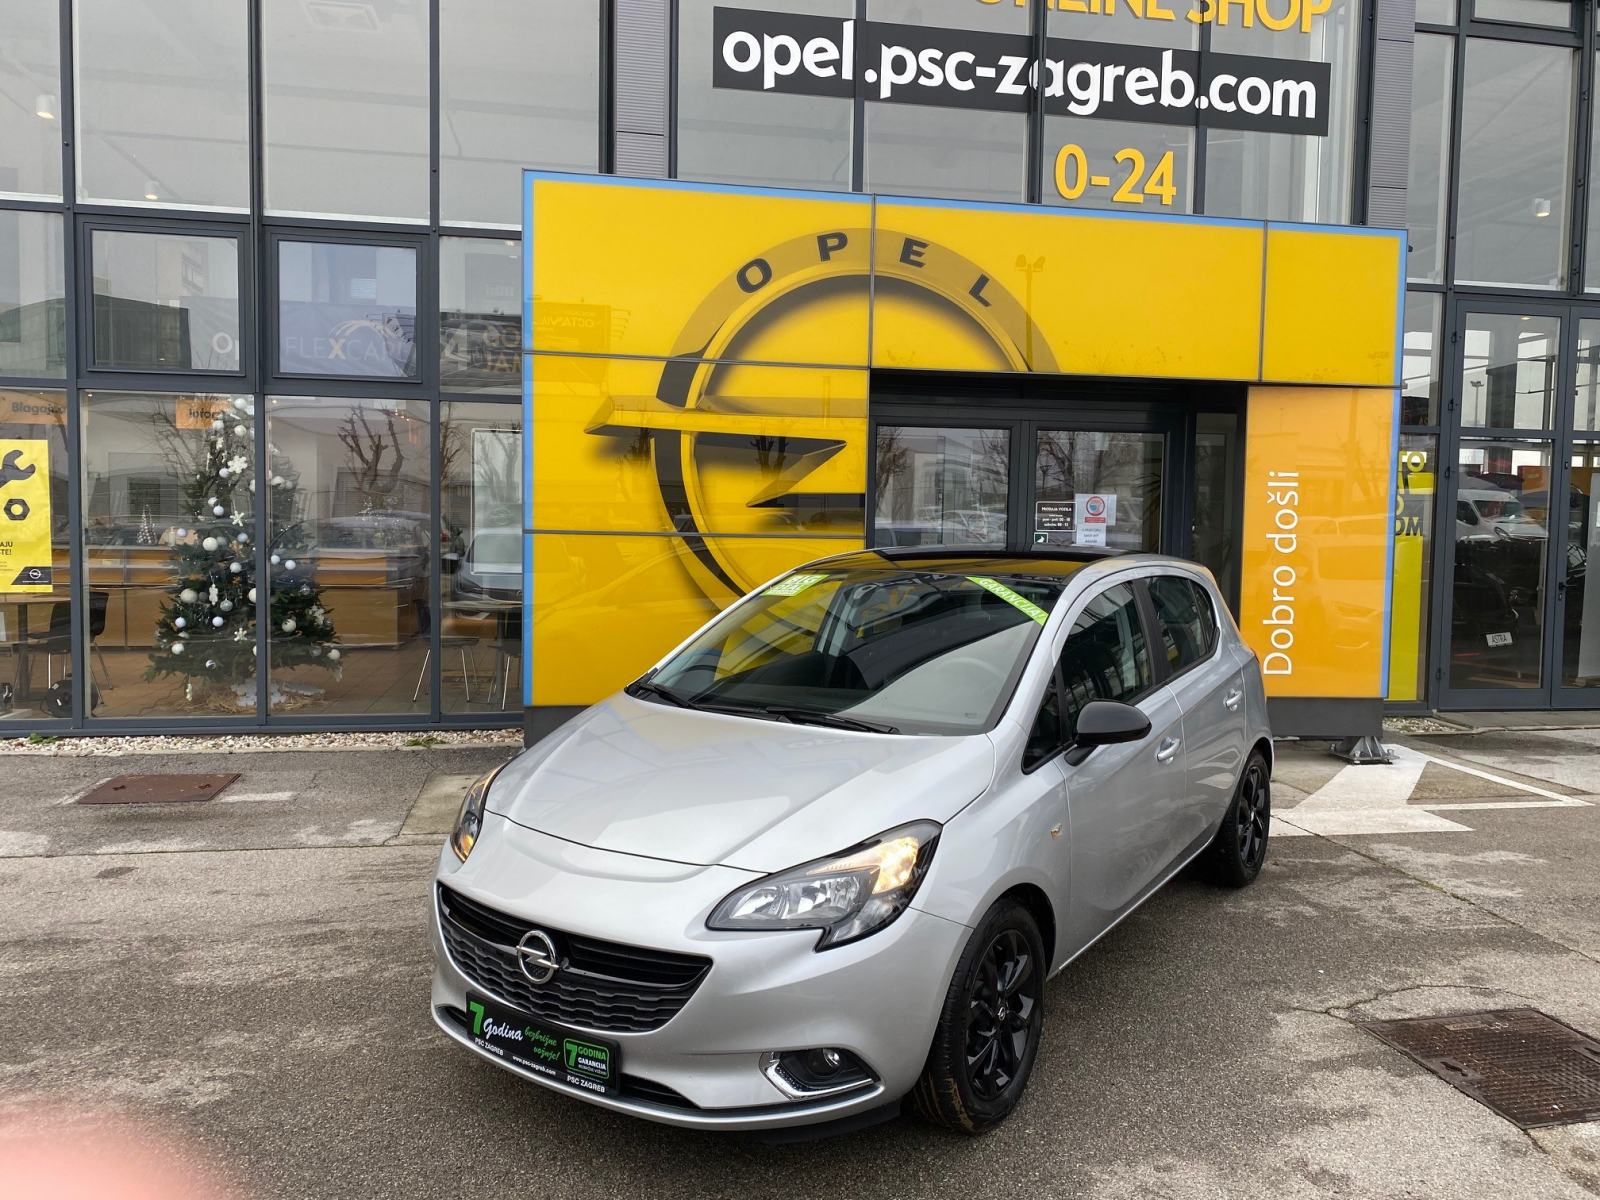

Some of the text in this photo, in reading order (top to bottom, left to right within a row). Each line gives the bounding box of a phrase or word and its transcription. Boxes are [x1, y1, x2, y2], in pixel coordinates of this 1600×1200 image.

[1055, 143, 1177, 205] 0-24
[736, 231, 993, 308] OPEL
[1263, 471, 1300, 675] Dobro došli
[469, 1001, 523, 1041] 7 Godina
[566, 1043, 607, 1067] 7 GODINA
[567, 1075, 606, 1093] PSC ZAGREB
